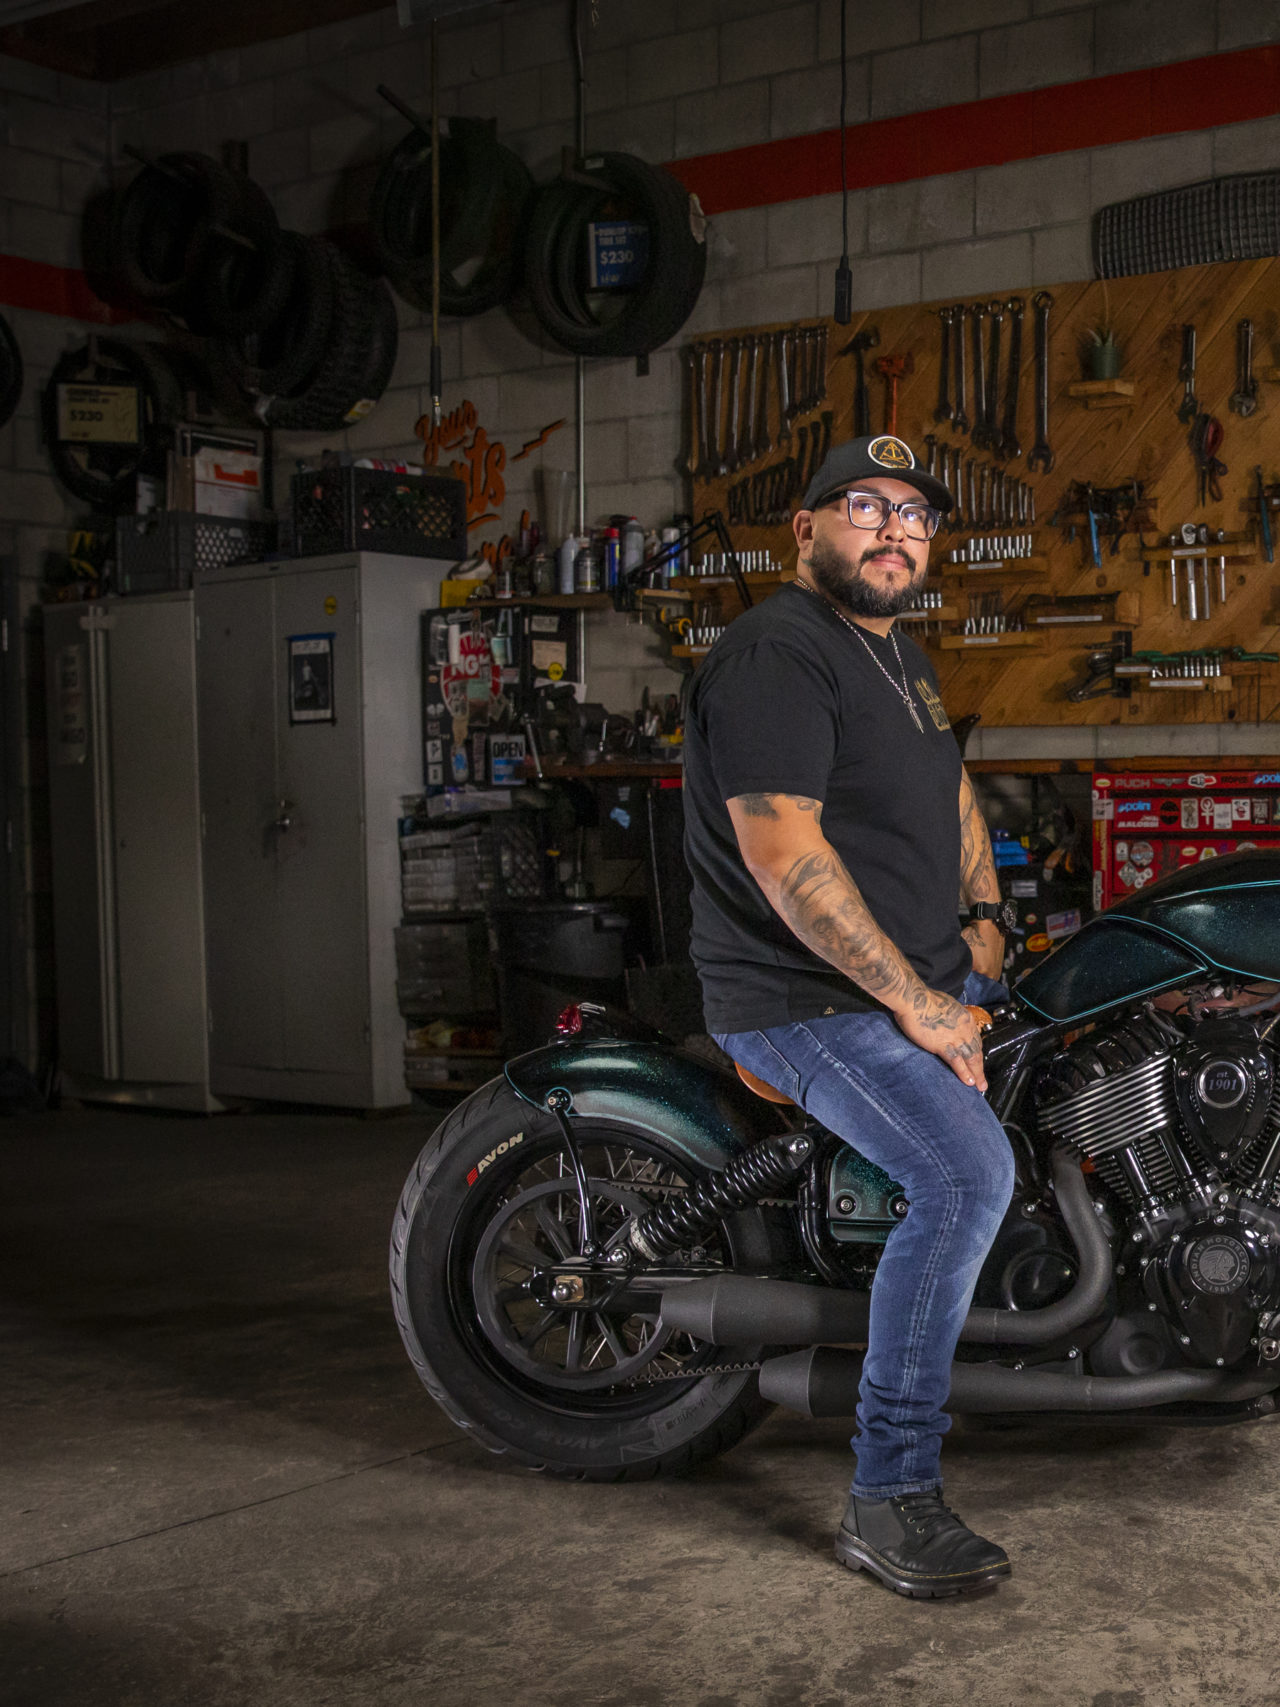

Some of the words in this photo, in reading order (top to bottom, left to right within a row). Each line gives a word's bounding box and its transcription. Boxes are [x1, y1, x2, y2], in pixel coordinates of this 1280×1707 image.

[600, 250, 634, 265] $230
[493, 741, 523, 757] OPEN
[1115, 778, 1150, 788] PUCH
[1123, 800, 1151, 812] polini
[1208, 1079, 1237, 1091] 1901
[478, 1132, 523, 1174] AVON
[1191, 1244, 1205, 1282] INDIAN
[1206, 1236, 1248, 1282] MOTORCYCLE
